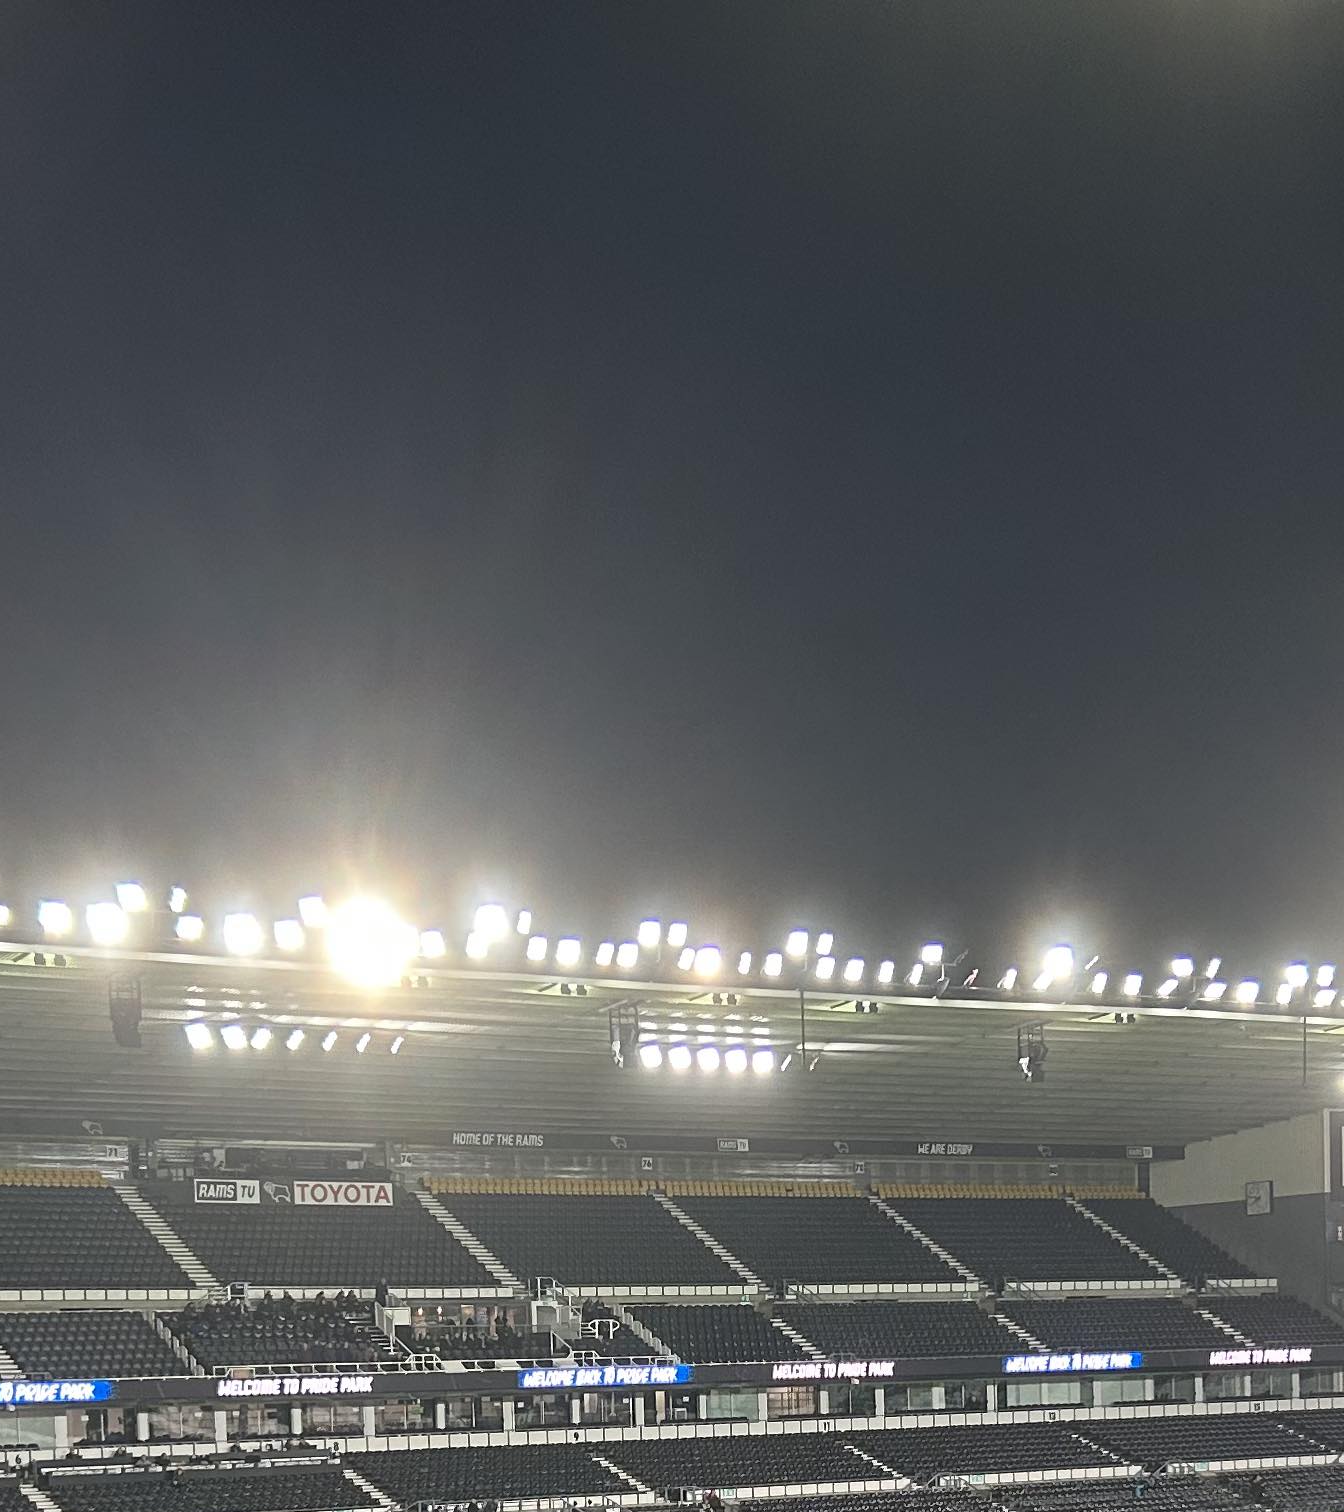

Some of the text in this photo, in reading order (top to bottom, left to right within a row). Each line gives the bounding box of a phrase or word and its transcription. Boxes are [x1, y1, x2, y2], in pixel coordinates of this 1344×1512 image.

[453, 1133, 544, 1148] HOME OF THE RAMS
[199, 1183, 255, 1199] RAMS TV
[296, 1184, 390, 1204] TOYOTA
[15, 1383, 59, 1402] PRIDE
[60, 1382, 96, 1401] PARK
[218, 1376, 374, 1396] WELCOME TO PRIDE PARK
[573, 1432, 580, 1441] 9
[333, 1442, 339, 1451] 8
[15, 1454, 22, 1464] 6
